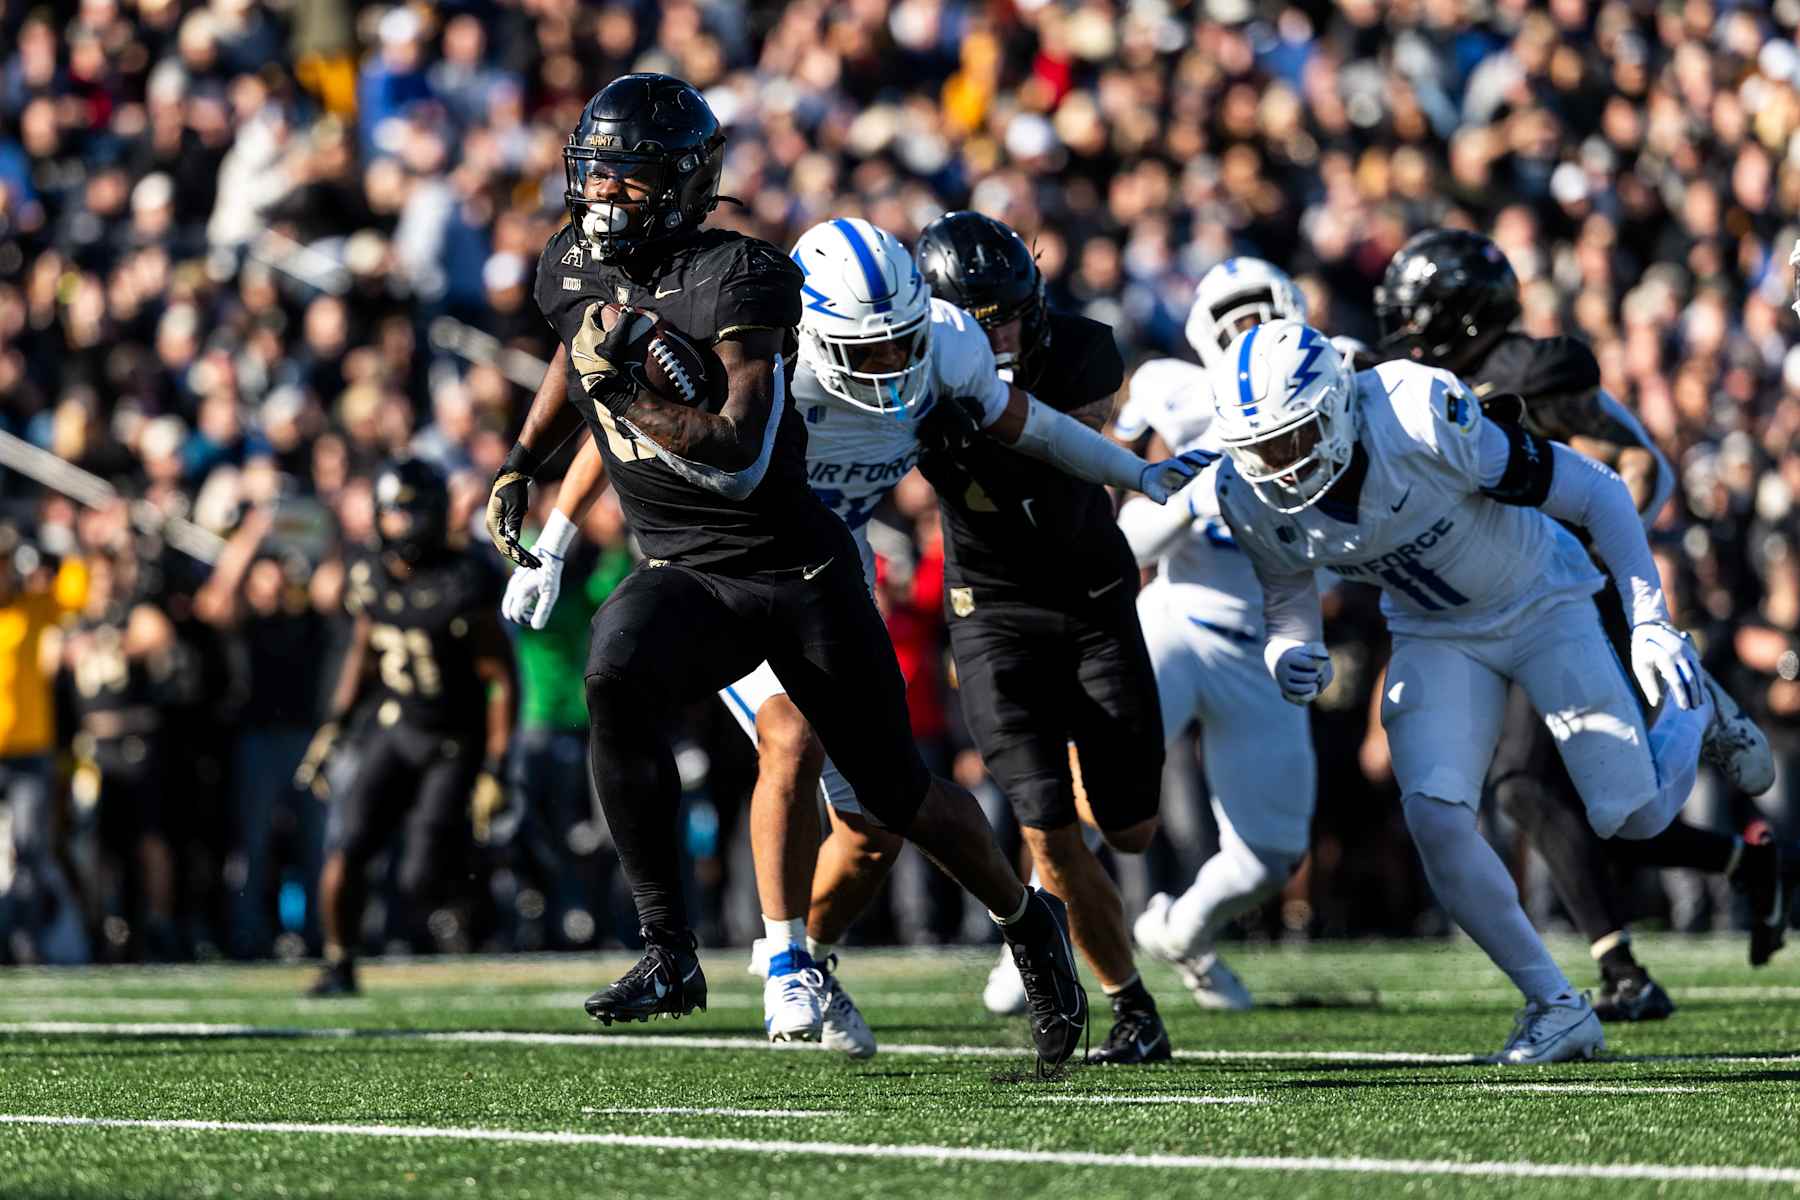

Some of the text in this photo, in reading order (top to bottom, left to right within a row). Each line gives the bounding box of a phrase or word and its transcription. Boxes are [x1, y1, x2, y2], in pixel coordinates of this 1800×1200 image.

[590, 134, 613, 147] ARMY
[807, 448, 927, 483] IR FORC
[1361, 516, 1455, 573] FORCE
